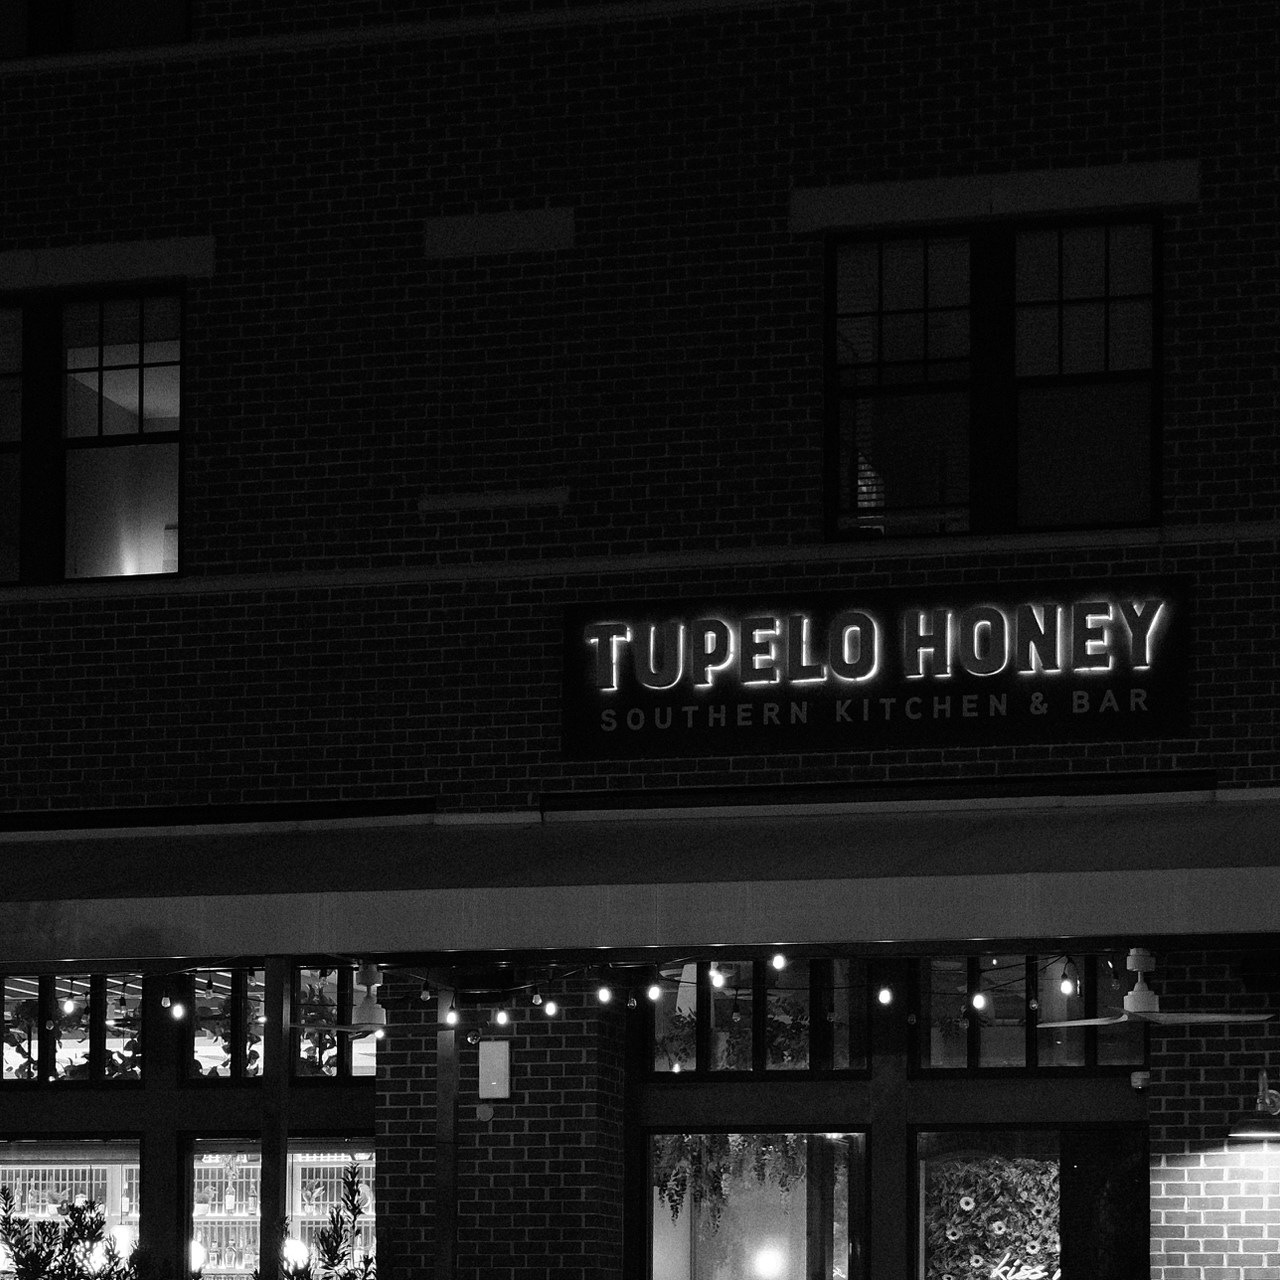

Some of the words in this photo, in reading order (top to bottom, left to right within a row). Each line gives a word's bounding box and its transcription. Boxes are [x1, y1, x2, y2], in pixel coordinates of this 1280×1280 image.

[586, 610, 879, 690] TUPELO
[904, 601, 1164, 677] HONEY
[599, 701, 809, 732] SOUTHERN
[835, 693, 1008, 723] KITCHEN
[1029, 691, 1049, 715] &
[1071, 688, 1149, 714] BAR
